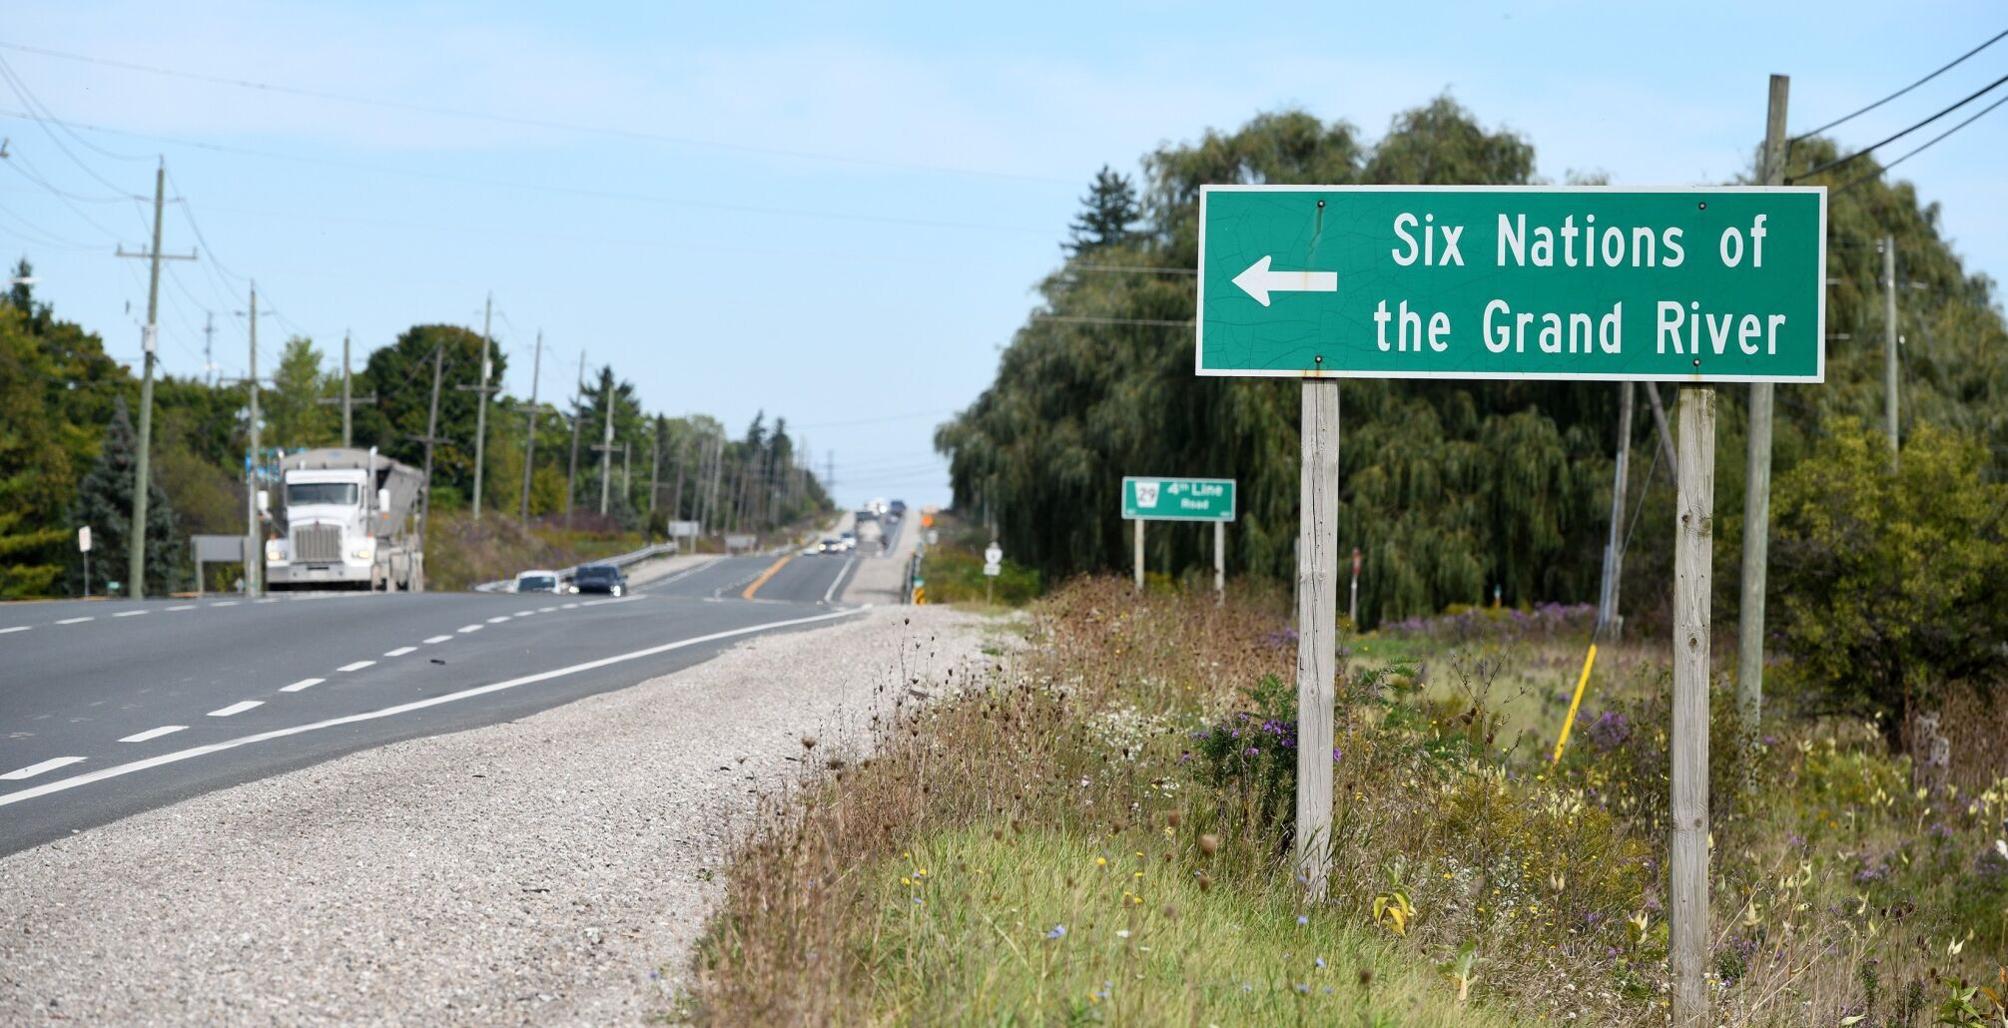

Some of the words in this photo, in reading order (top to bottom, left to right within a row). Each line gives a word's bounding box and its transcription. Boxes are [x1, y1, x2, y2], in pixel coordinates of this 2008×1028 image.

[1392, 213, 1465, 266] Six
[1497, 213, 1685, 268] Nations
[1719, 214, 1767, 268] of
[1373, 299, 1451, 352] the
[1483, 299, 1622, 354] Grand
[1656, 300, 1786, 355] River
[1180, 498, 1209, 510] Road
[1191, 483, 1223, 496] Line
